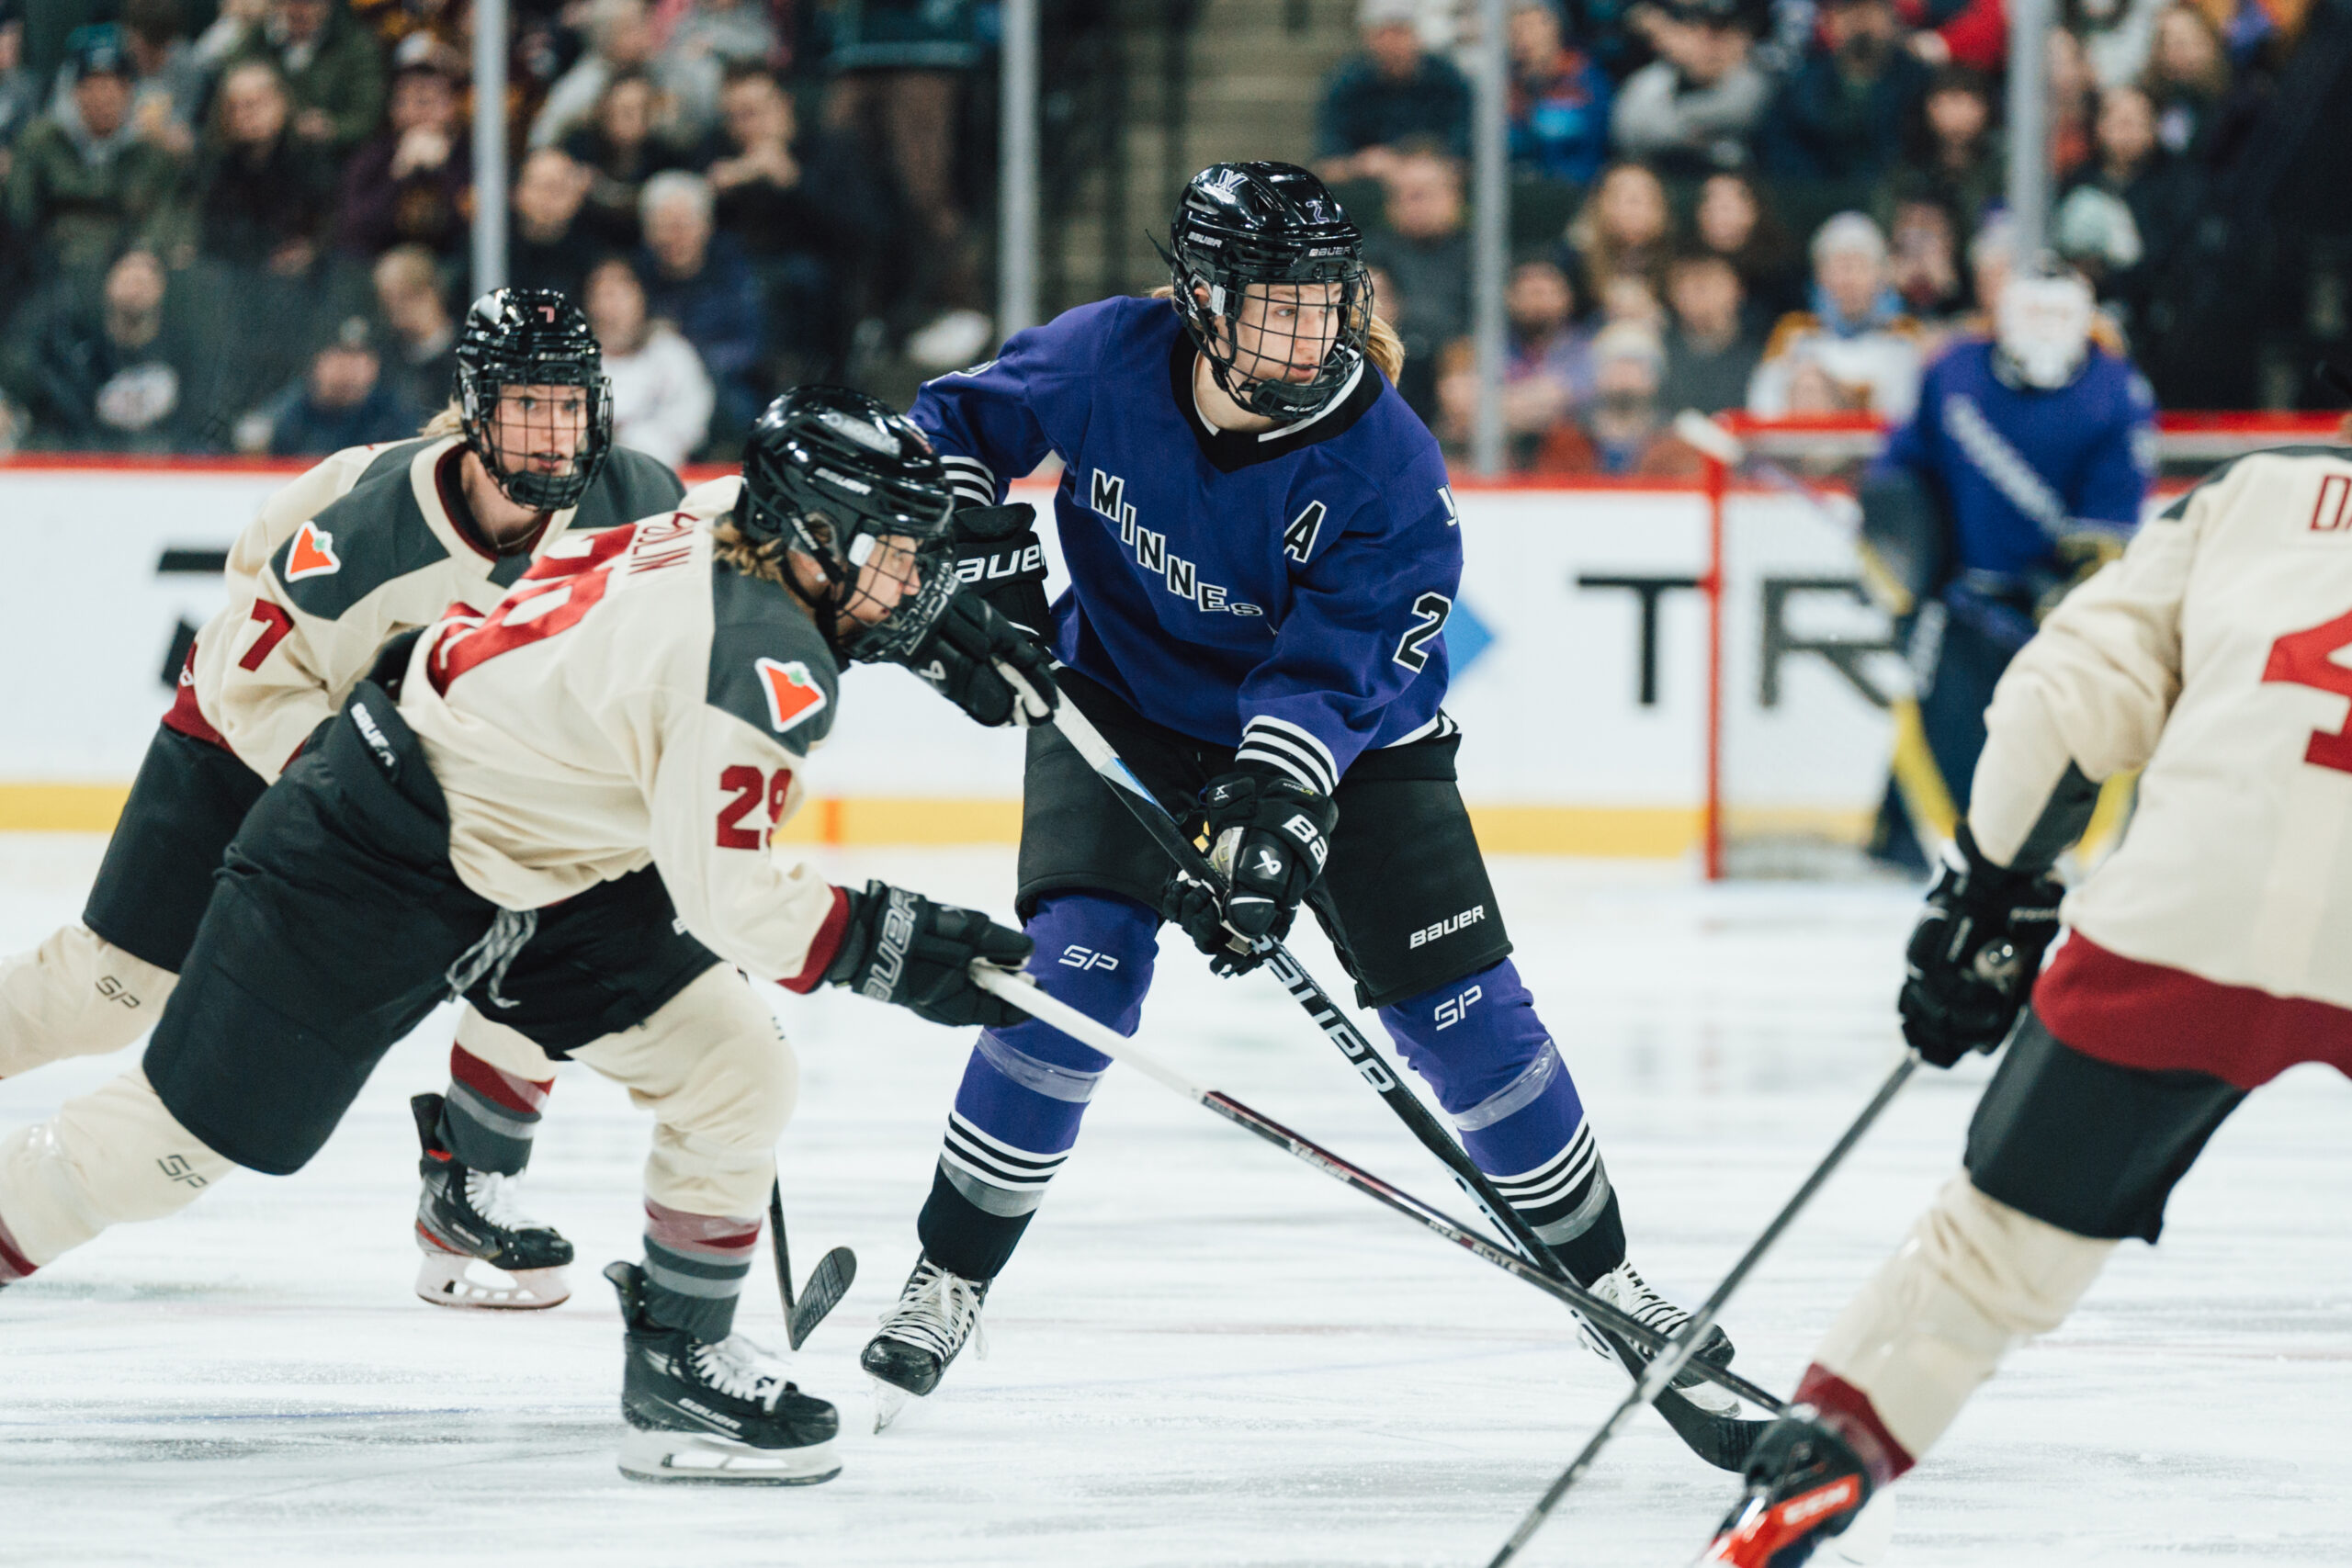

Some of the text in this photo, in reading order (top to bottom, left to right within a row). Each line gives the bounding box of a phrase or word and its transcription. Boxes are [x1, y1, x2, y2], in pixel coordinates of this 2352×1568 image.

[1187, 231, 1223, 248] BAUER
[1308, 245, 1351, 257] BAUER
[537, 306, 556, 323] 7
[814, 467, 872, 496] BAUER
[2309, 474, 2352, 531] D
[1091, 468, 1264, 616] MINNES
[1283, 499, 1327, 563] A
[954, 543, 1046, 584] AUE
[238, 597, 295, 672] 7
[1392, 591, 1453, 674] 2
[717, 764, 792, 851] 29
[862, 886, 918, 1003] AUER
[1410, 904, 1486, 950] BAUER
[1057, 944, 1119, 971] SP
[95, 975, 141, 1009] SP
[1434, 985, 1483, 1032] SP
[156, 1154, 209, 1189] SP
[677, 1396, 742, 1431] BAUER
